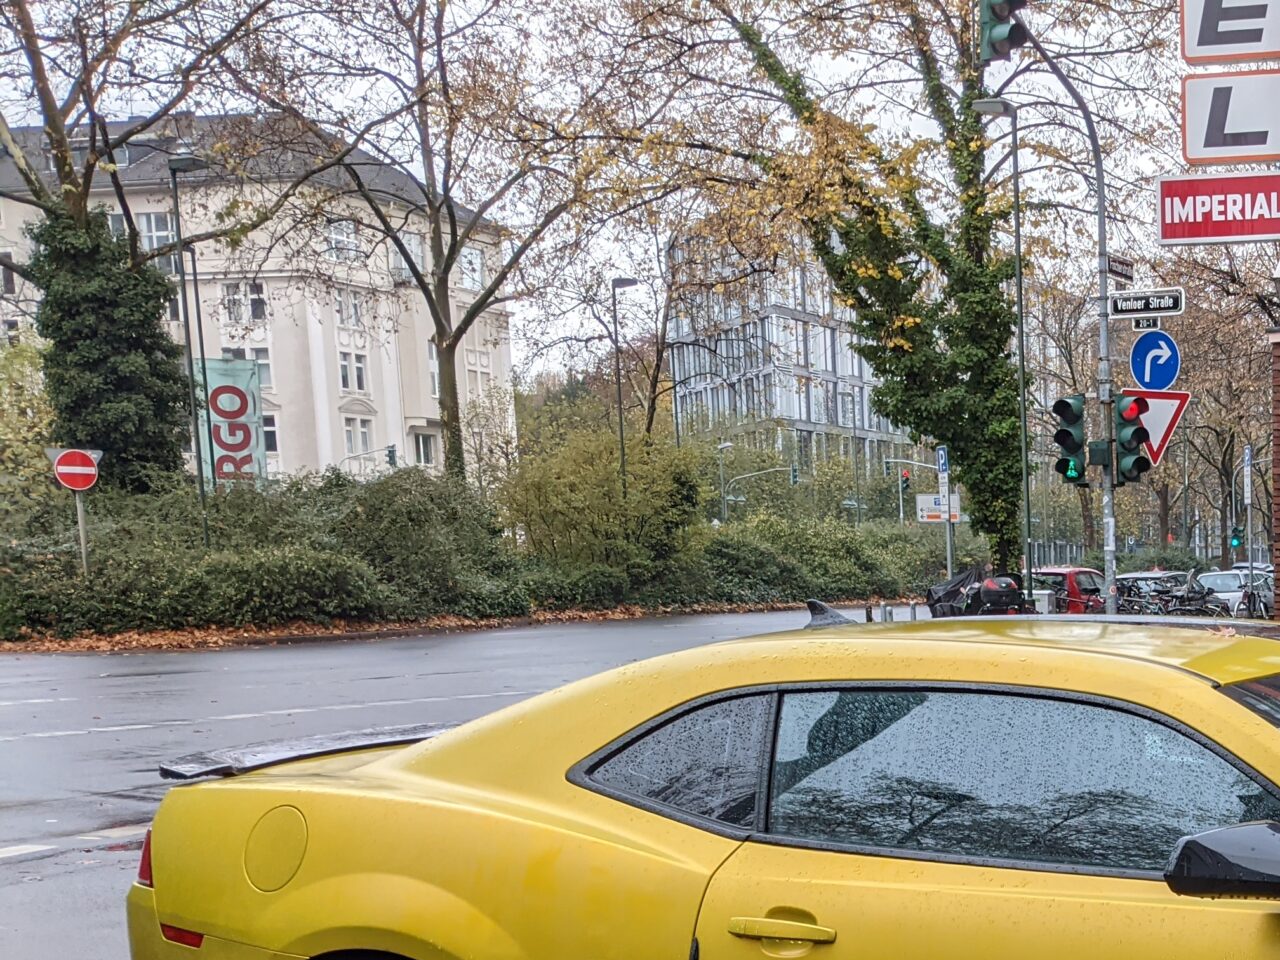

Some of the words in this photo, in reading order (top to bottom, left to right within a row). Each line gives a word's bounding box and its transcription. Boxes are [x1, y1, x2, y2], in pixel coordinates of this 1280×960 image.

[1117, 298, 1146, 310] Venloer
[1149, 295, 1174, 309] Straße
[209, 385, 254, 492] RGO
